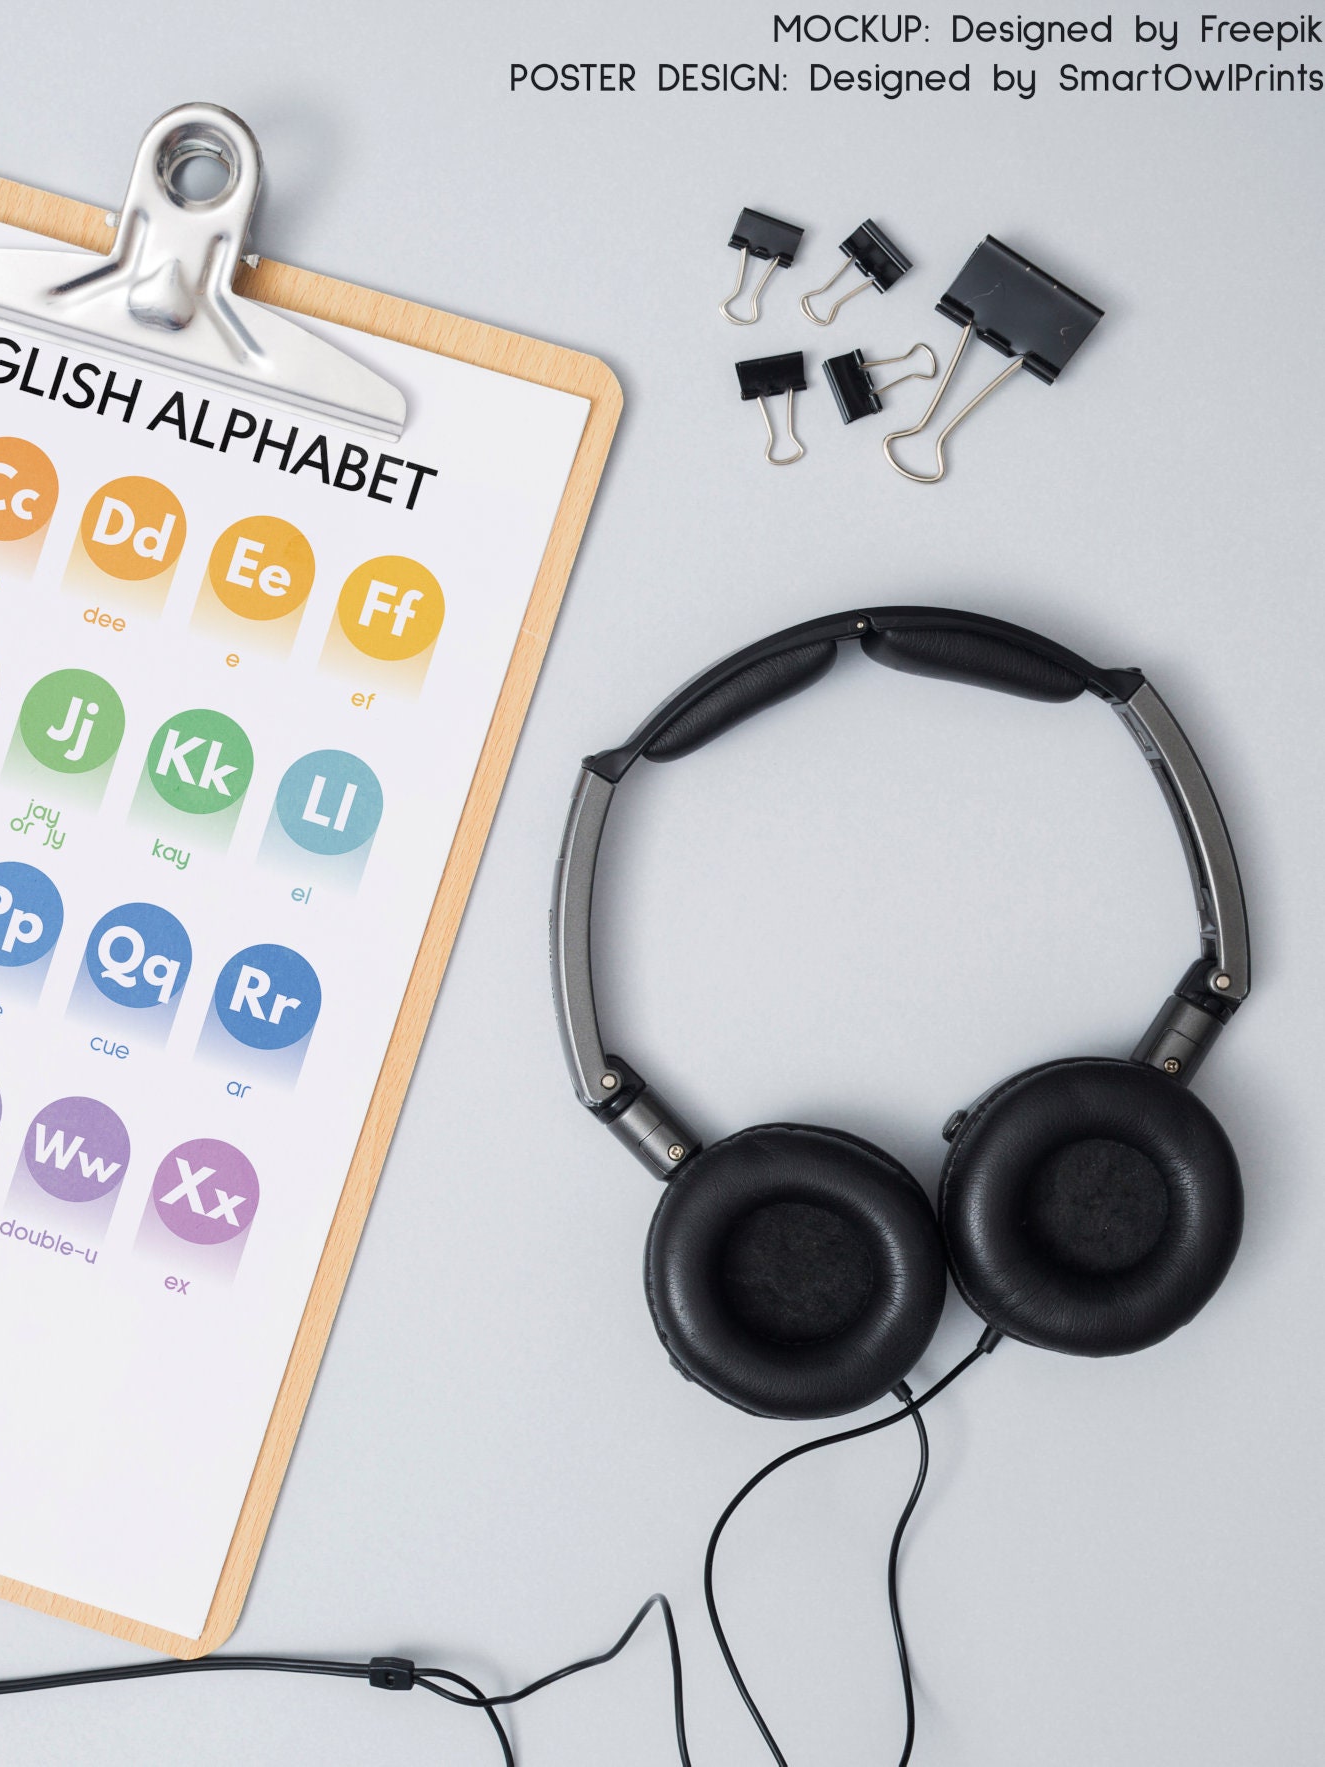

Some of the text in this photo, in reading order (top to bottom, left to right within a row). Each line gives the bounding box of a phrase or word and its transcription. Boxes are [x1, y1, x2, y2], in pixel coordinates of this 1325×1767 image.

[145, 390, 439, 511] ALPHABET
[92, 496, 176, 561] Dd
[226, 537, 291, 597] Ee
[358, 580, 423, 637] Ff
[82, 606, 127, 633] dee
[225, 653, 241, 668] e
[350, 692, 377, 711] ef
[46, 696, 99, 761] Jj
[155, 729, 238, 796] Kk
[302, 775, 358, 832] Ll
[22, 797, 62, 830] jay
[9, 817, 67, 851] or jy
[151, 838, 191, 871] kay
[290, 887, 313, 905] el
[97, 925, 181, 1005] Qq
[229, 964, 301, 1025] Rr
[90, 1036, 130, 1060] cue
[226, 1080, 252, 1099] ar
[35, 1122, 122, 1183] Ww
[159, 1157, 246, 1227] Xx
[0, 1219, 98, 1265] double-u
[164, 1275, 191, 1295] ex
